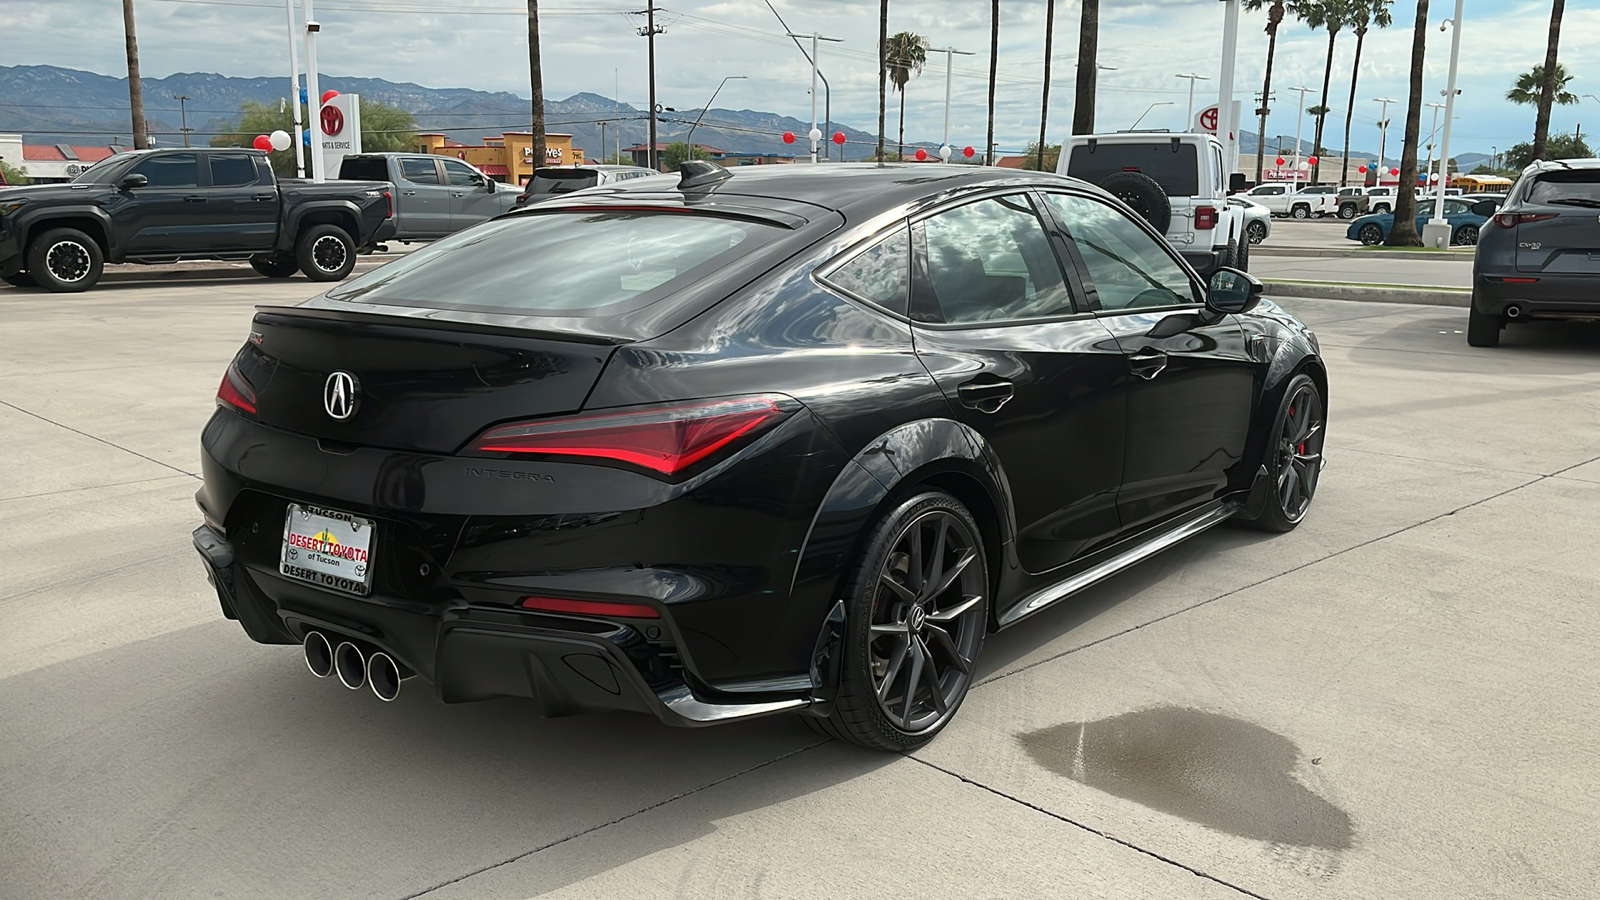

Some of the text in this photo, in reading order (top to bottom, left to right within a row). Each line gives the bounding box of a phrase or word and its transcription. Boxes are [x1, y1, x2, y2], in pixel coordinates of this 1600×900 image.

[334, 141, 350, 149] SERVICE
[464, 468, 555, 483] INTEGRA
[308, 506, 352, 522] TUCSON
[290, 533, 368, 562] DESERT TOYOTA
[307, 553, 340, 567] of Tucson
[283, 564, 361, 593] DESERT TOYOTA
